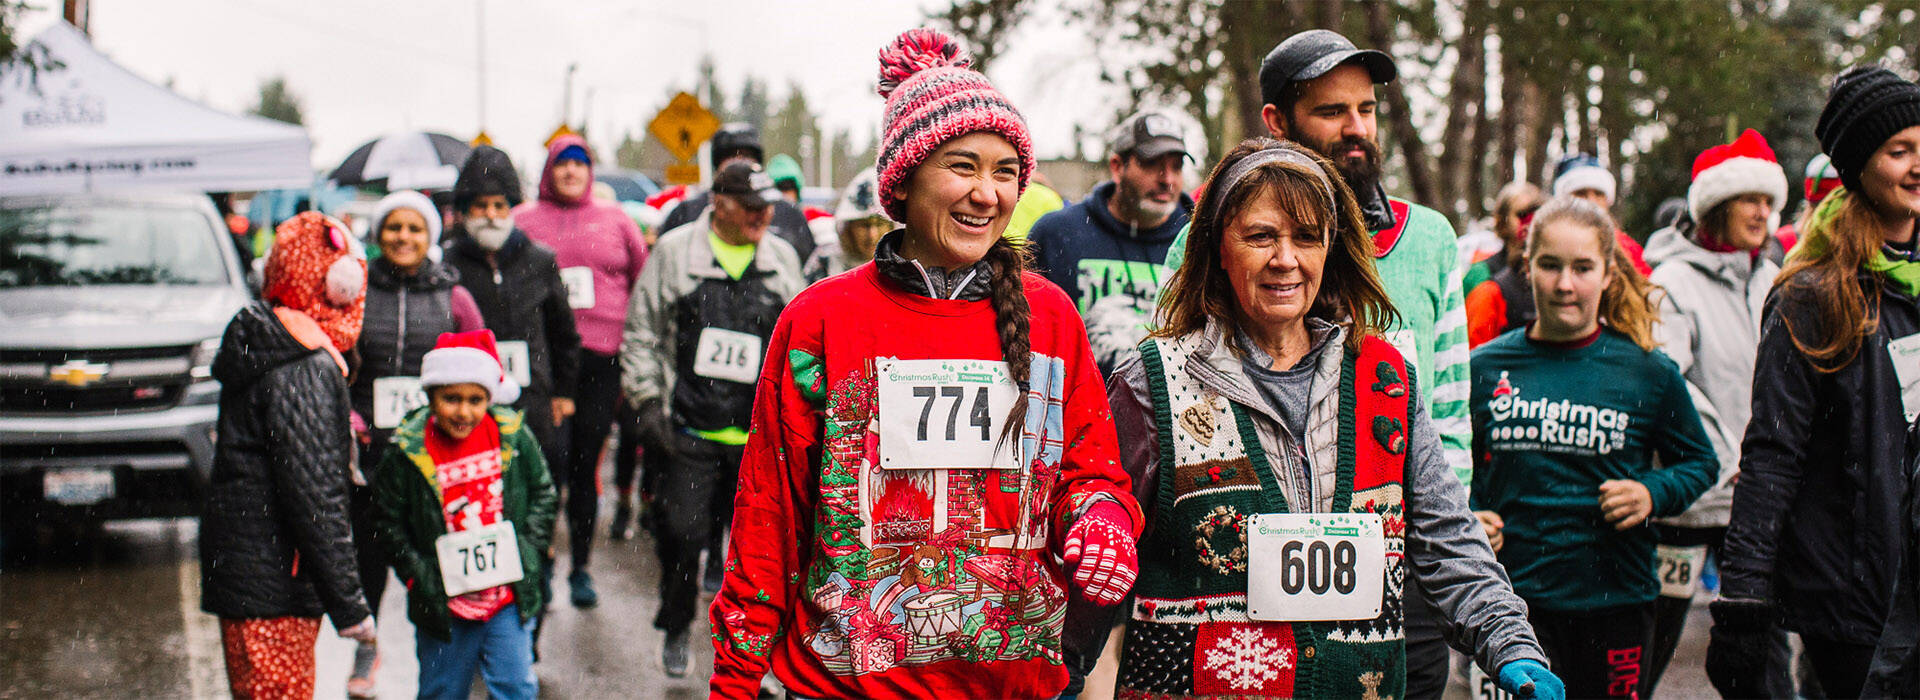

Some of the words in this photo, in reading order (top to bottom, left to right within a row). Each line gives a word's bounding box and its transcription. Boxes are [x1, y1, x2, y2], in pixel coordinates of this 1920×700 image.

[710, 341, 748, 368] 216
[913, 386, 991, 441] 774
[1488, 394, 1629, 431] Christmas
[1540, 418, 1611, 455] Rush
[458, 541, 497, 576] 767
[1281, 540, 1356, 595] 608
